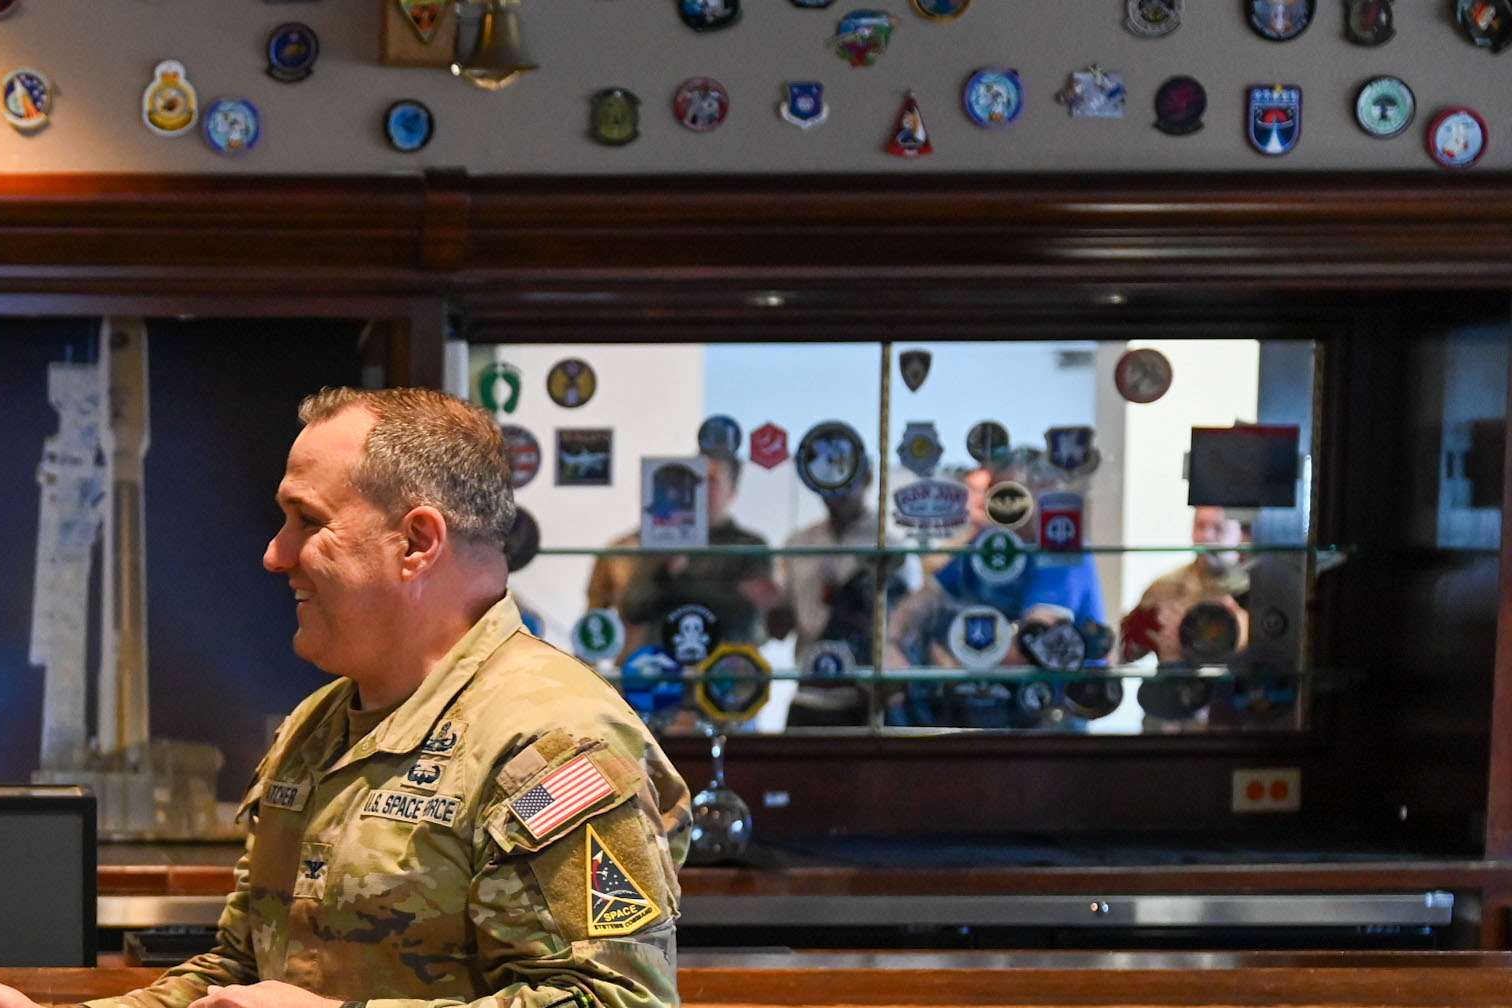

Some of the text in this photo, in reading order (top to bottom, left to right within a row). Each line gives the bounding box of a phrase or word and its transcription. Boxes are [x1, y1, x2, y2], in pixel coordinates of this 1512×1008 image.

[364, 792, 456, 822] U.S. SPACE RCE
[603, 904, 638, 922] SPACE
